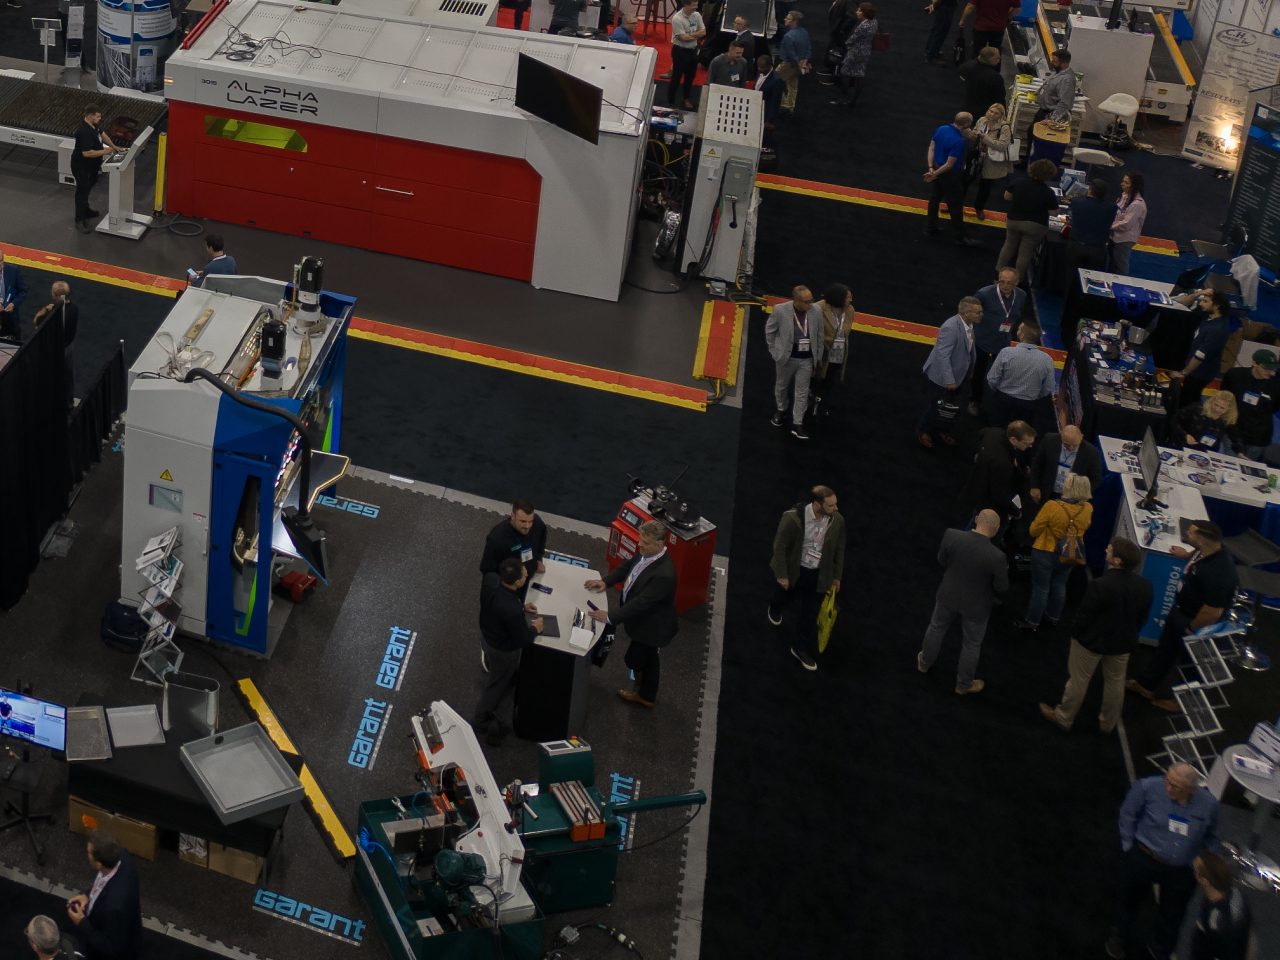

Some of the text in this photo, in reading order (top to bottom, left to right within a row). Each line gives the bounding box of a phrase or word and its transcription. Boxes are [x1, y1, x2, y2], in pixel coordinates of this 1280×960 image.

[1225, 29, 1247, 40] C.H.
[227, 79, 319, 105] ALPHA
[227, 91, 319, 117] LAZER
[1162, 565, 1181, 617] FORGESTIK
